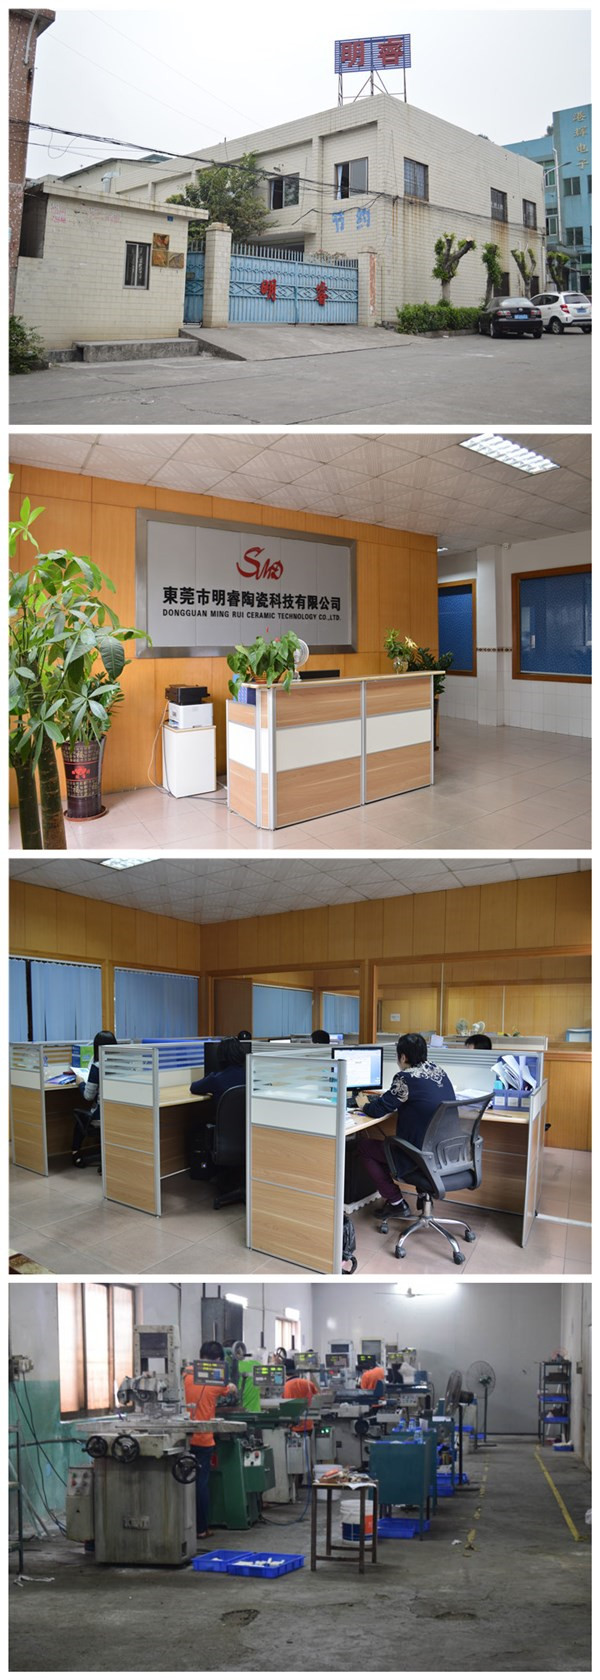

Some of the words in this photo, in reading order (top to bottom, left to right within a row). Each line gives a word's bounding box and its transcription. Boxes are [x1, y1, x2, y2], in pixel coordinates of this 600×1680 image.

[162, 586, 341, 611] 東莞市明睿陶瓷科技有限公司
[162, 608, 208, 617] DONGGUAN
[210, 610, 230, 618] MING
[246, 611, 276, 620] CERAMIC
[277, 612, 317, 620] TECHNOLOGY
